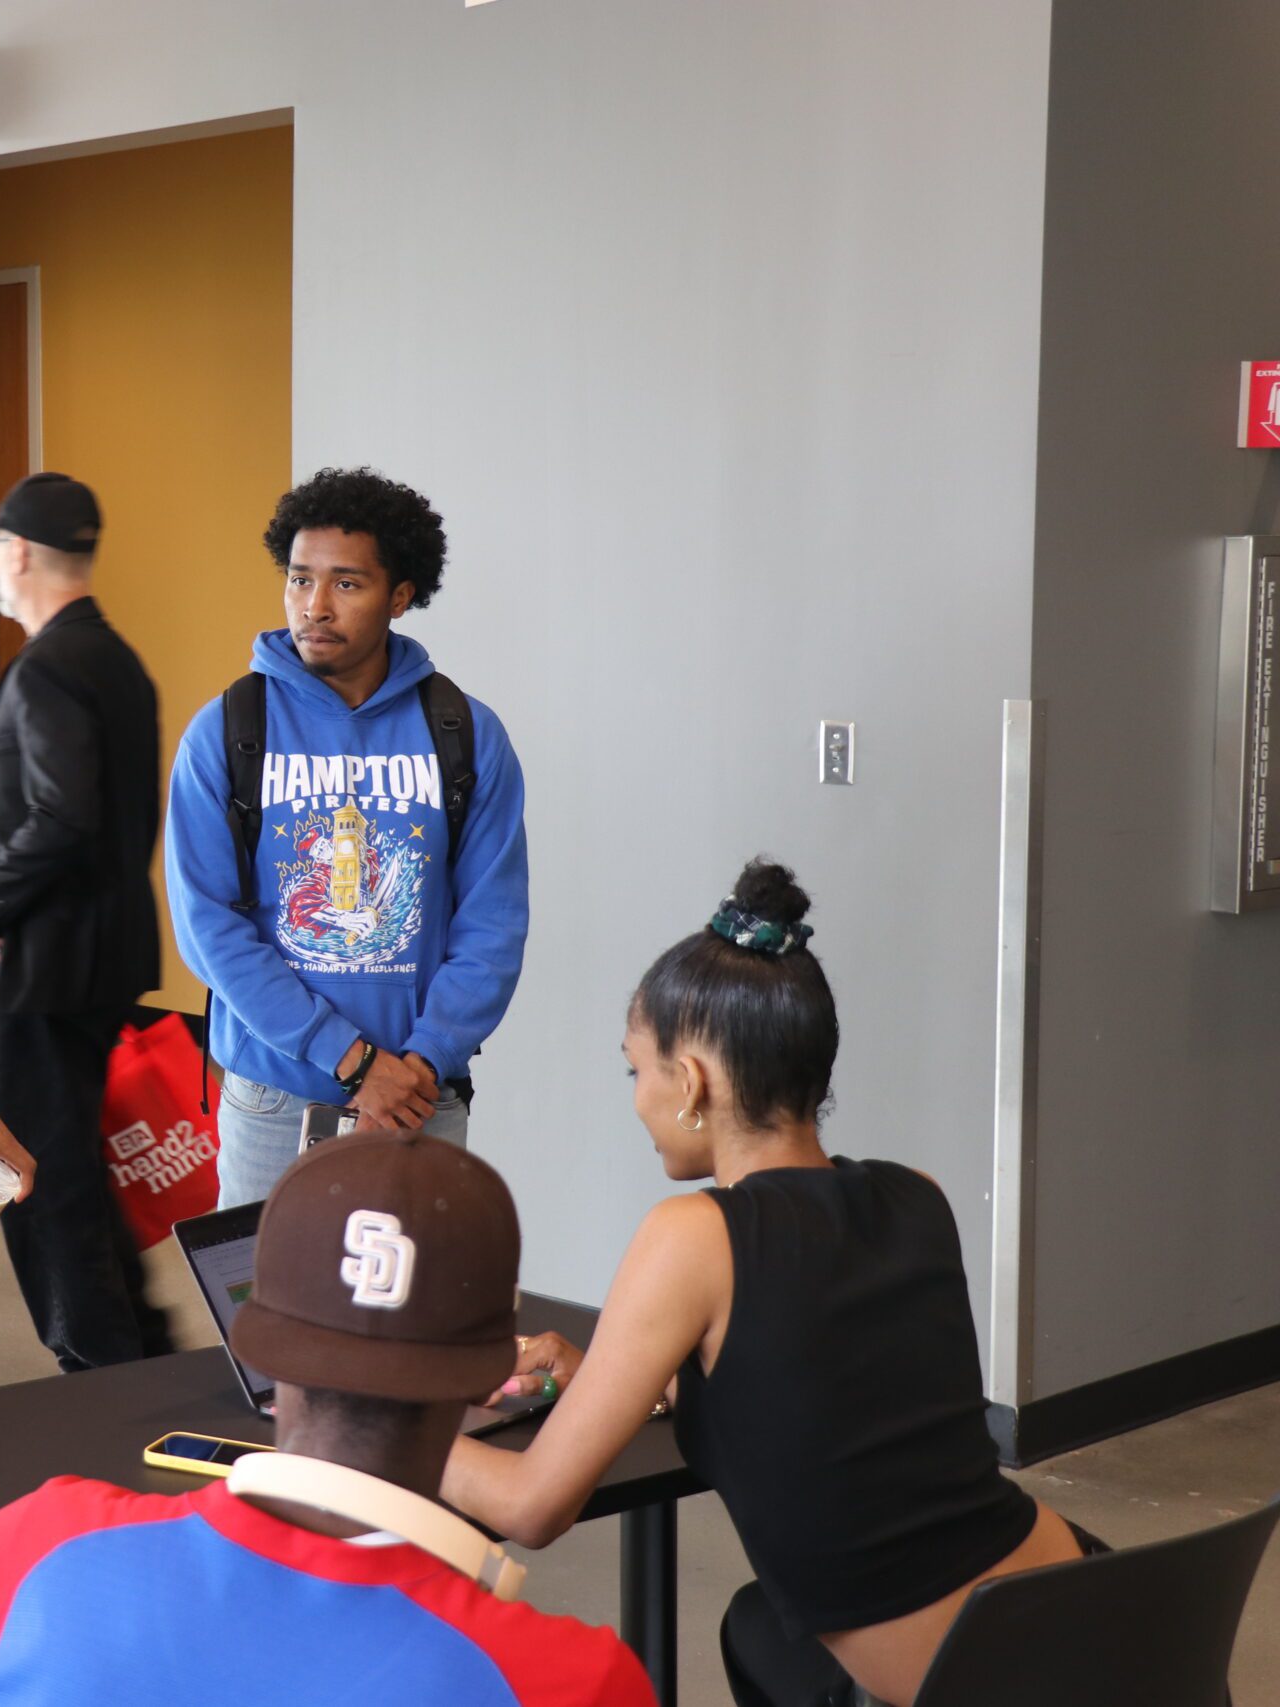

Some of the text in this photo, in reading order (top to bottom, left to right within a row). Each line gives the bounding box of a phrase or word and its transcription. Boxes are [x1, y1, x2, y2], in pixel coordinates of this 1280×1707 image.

[1256, 581, 1276, 862] FIRE EXTINGUISHER
[261, 752, 441, 810] HAMPTON
[290, 794, 411, 815] PIRATES
[303, 961, 347, 974] STANDARD
[350, 963, 360, 973] OF
[364, 963, 417, 974] EXCELLENCE
[108, 1119, 198, 1188] hand2
[144, 1133, 219, 1195] mind
[340, 1208, 417, 1310] SD
